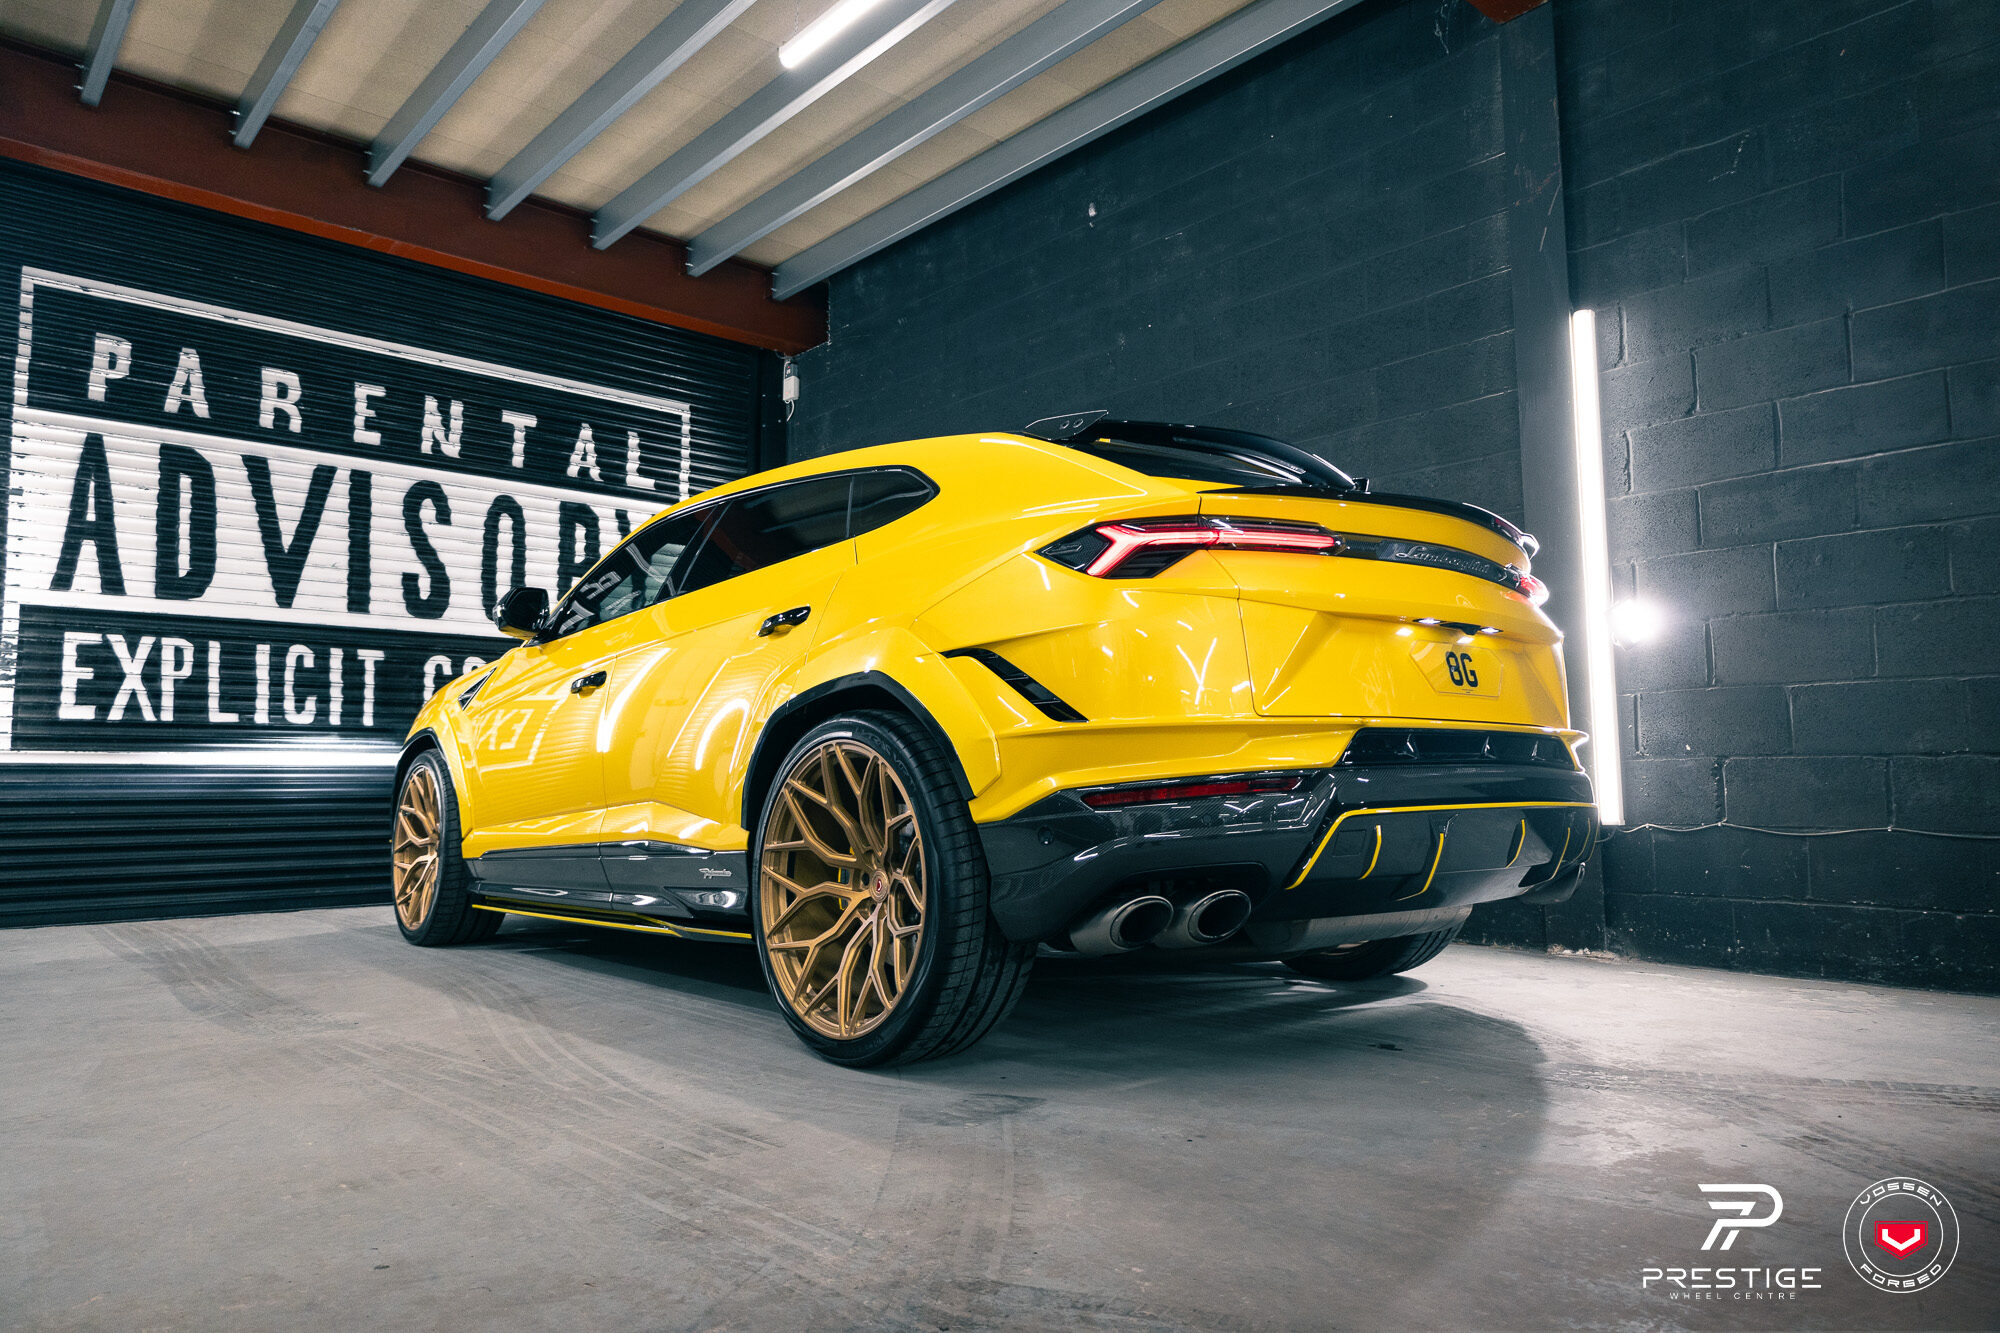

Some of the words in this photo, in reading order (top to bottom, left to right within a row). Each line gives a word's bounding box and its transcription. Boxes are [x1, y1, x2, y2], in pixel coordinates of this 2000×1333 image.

[86, 332, 657, 490] PARENTAL
[58, 631, 386, 727] EXPLICIT
[1445, 651, 1479, 688] 8G
